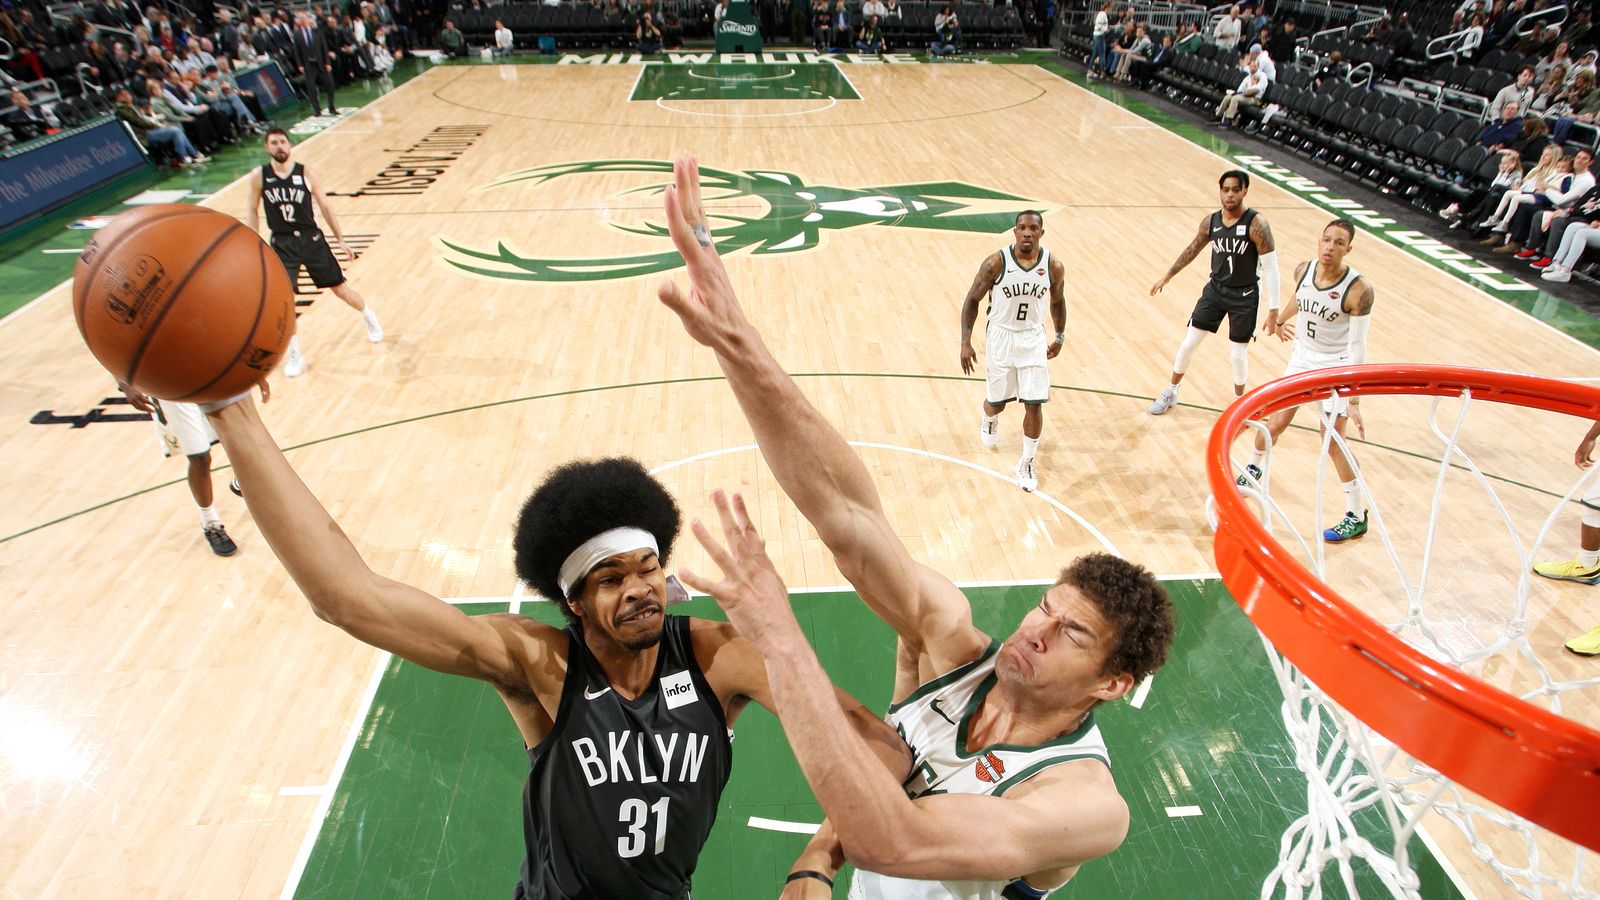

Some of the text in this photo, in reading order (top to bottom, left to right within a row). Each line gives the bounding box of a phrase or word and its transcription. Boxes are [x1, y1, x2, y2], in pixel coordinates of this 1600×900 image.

[720, 22, 757, 34] SARGENTO
[556, 52, 922, 65] MILWAUKEE
[24, 155, 95, 193] Milwaukee
[89, 139, 127, 166] Bucks
[264, 187, 305, 204] BKLYN
[279, 203, 296, 222] 12
[1227, 255, 1233, 275] 1
[1002, 282, 1047, 299] BUCKS
[1016, 303, 1029, 321] 6
[1307, 320, 1317, 339] 5
[665, 682, 692, 698] infor
[571, 730, 709, 787] BKLYN
[617, 796, 670, 859] 31
